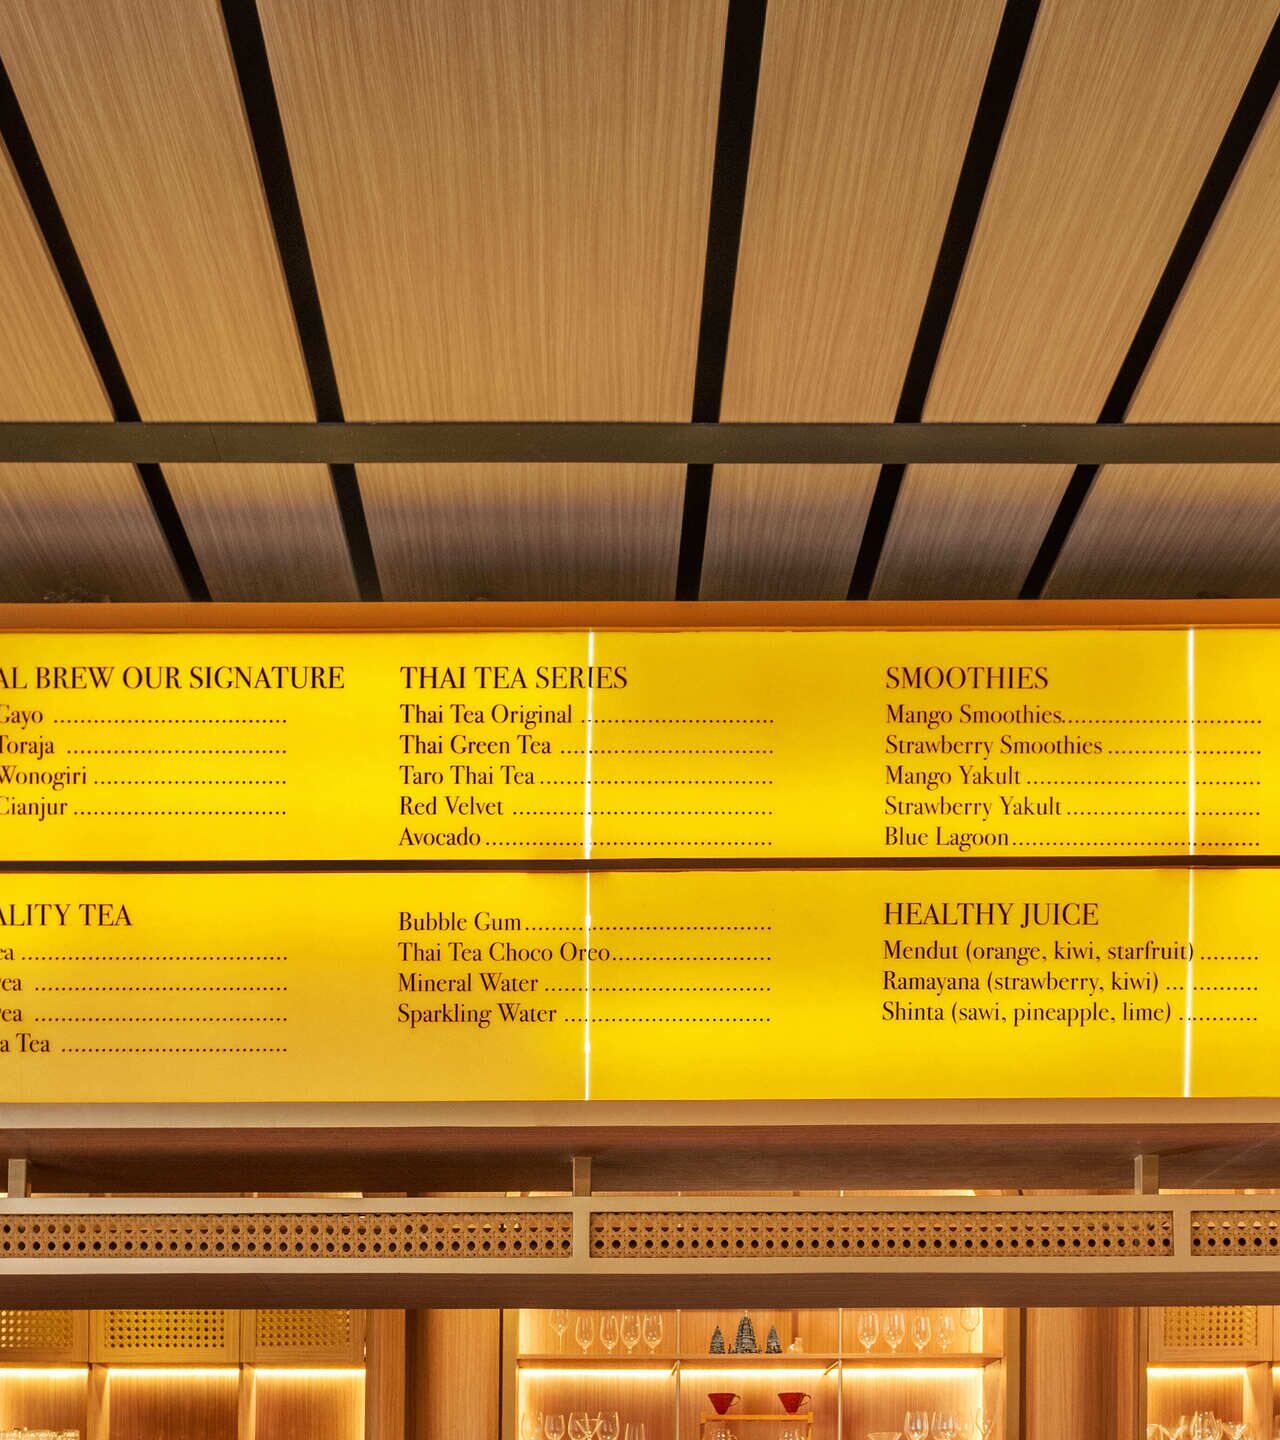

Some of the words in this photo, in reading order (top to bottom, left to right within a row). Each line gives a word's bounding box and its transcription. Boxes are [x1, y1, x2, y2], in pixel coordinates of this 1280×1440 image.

[36, 666, 114, 689] BREW
[123, 666, 182, 689] OUR
[190, 666, 344, 689] SIGNATURE
[400, 667, 465, 688] THAI
[474, 667, 528, 688] TEA
[536, 666, 627, 689] SERIES
[886, 666, 1048, 689] SMOOTHIES
[400, 704, 443, 723] Thai
[450, 704, 484, 723] Tea
[491, 704, 571, 730] Original
[887, 704, 952, 730] Mango
[960, 704, 1063, 724] Smoothies
[400, 735, 443, 754] Thai
[450, 735, 510, 754] Green
[517, 735, 552, 754] Tea
[886, 735, 993, 760] Strawberry
[1000, 735, 1102, 754] Smoothies
[399, 765, 443, 784] Taro
[450, 765, 493, 784] Thai
[500, 765, 535, 784] Tea
[886, 765, 951, 791] Mango
[959, 765, 1020, 784] Yakult
[401, 796, 436, 815] Red
[445, 796, 503, 815] Velvet
[885, 796, 992, 821] Strawberry
[1000, 796, 1060, 815] Yakult
[399, 826, 480, 846] Avocado
[886, 826, 928, 845] Blue
[936, 827, 1008, 852] Lagoon
[79, 904, 133, 926] TEA
[400, 912, 467, 931] Bubble
[474, 912, 521, 931] Gum
[884, 902, 1014, 925] HEALTHY
[1020, 903, 1098, 928] JUICE
[398, 942, 441, 961] Thai
[448, 942, 482, 961] Tea
[489, 942, 553, 961] Choco
[560, 942, 610, 961] Oreo
[884, 940, 958, 959] Mendut
[966, 941, 1046, 966] (orange,
[1054, 940, 1100, 962] kiwi,
[1108, 940, 1193, 961] starfruit)
[399, 973, 472, 992] Mineral
[479, 972, 539, 992] Water
[883, 971, 980, 996] Ramayana
[988, 971, 1104, 996] (strawberry,
[1112, 971, 1158, 993] kiwi)
[398, 1003, 492, 1029] Sparkling
[497, 1003, 557, 1024] Water
[882, 1001, 944, 1020] Shinta
[952, 1002, 1006, 1024] (sawi,
[1014, 1002, 1115, 1027] pineapple,
[1123, 1002, 1171, 1023] lime)
[16, 1033, 50, 1052] Tea
